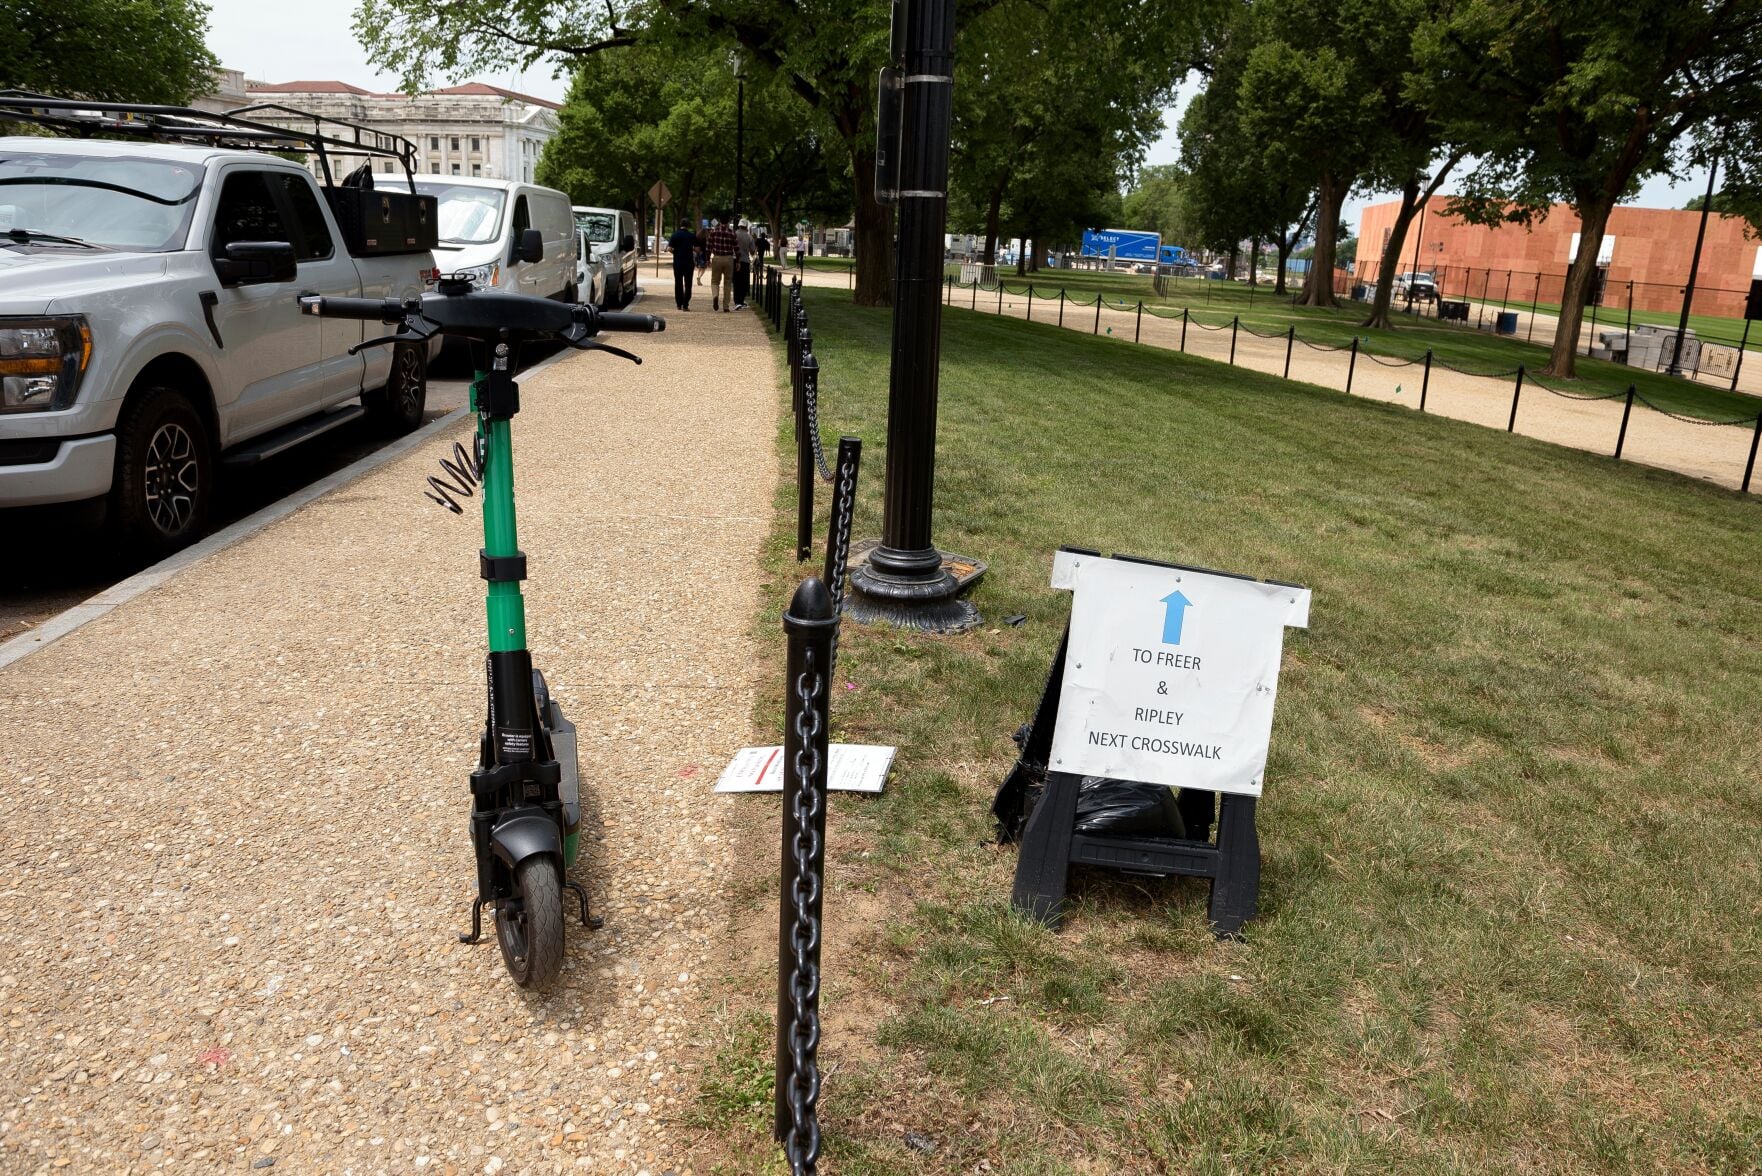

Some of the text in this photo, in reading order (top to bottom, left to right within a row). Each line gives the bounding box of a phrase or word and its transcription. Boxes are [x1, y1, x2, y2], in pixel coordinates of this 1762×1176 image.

[1132, 648, 1201, 671] TO FREER
[1156, 680, 1168, 695] &
[1134, 707, 1184, 726] RIPLEY
[1088, 731, 1222, 760] NEXT CROSSWALK
